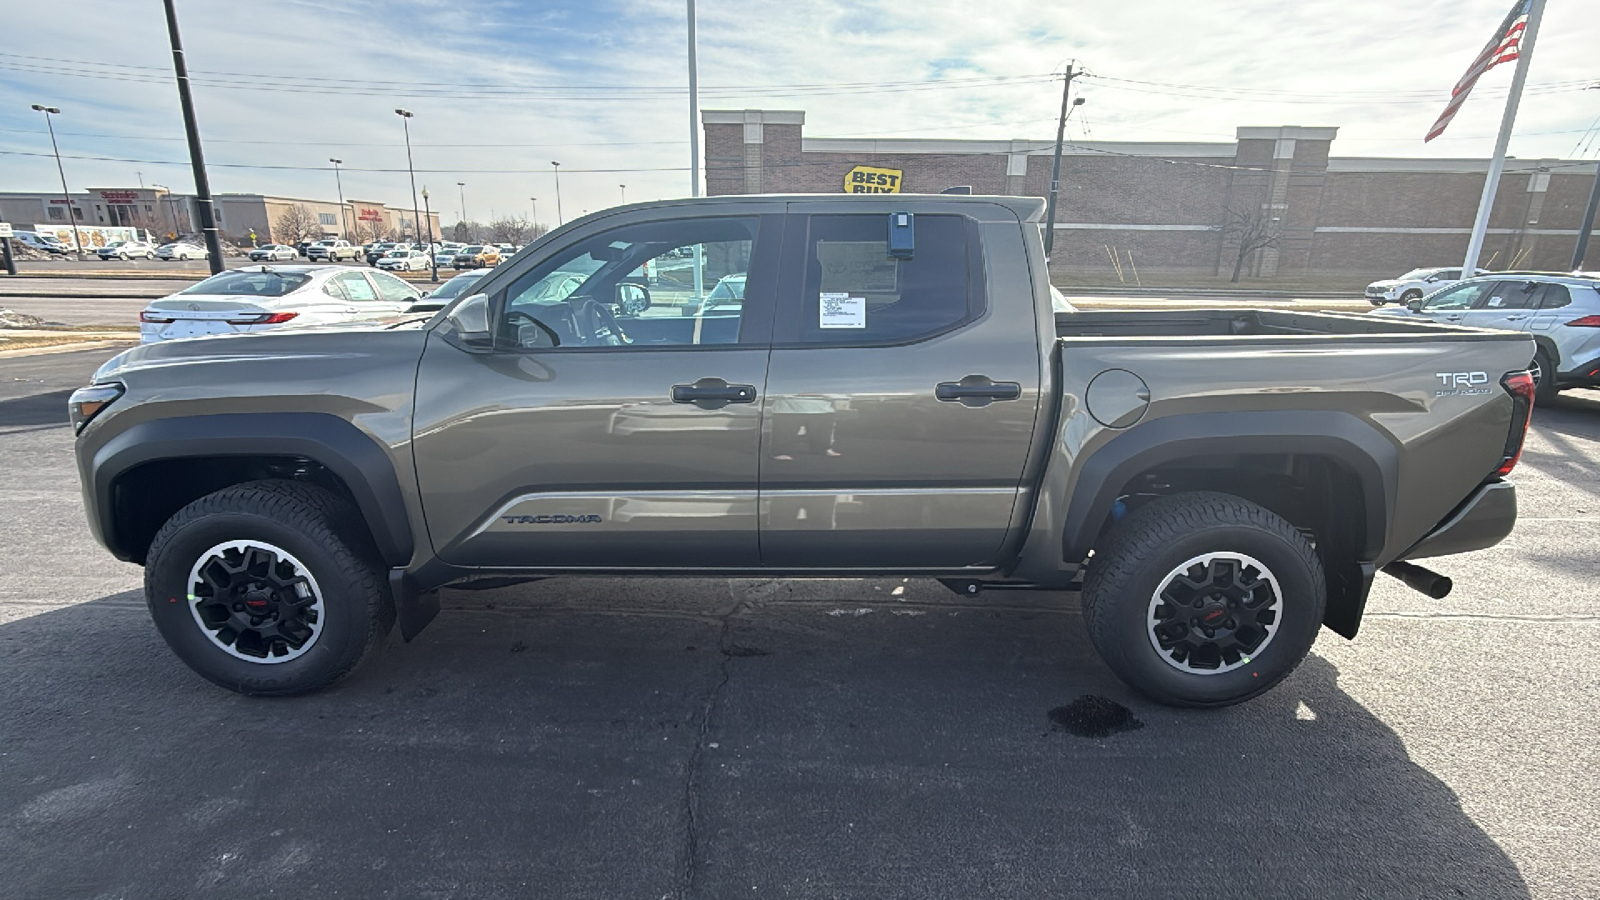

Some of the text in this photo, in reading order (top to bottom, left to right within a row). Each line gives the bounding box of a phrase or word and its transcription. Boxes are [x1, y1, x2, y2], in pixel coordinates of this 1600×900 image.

[852, 171, 899, 187] BEST
[1435, 371, 1488, 389] TRD
[502, 514, 602, 524] TACOMA
